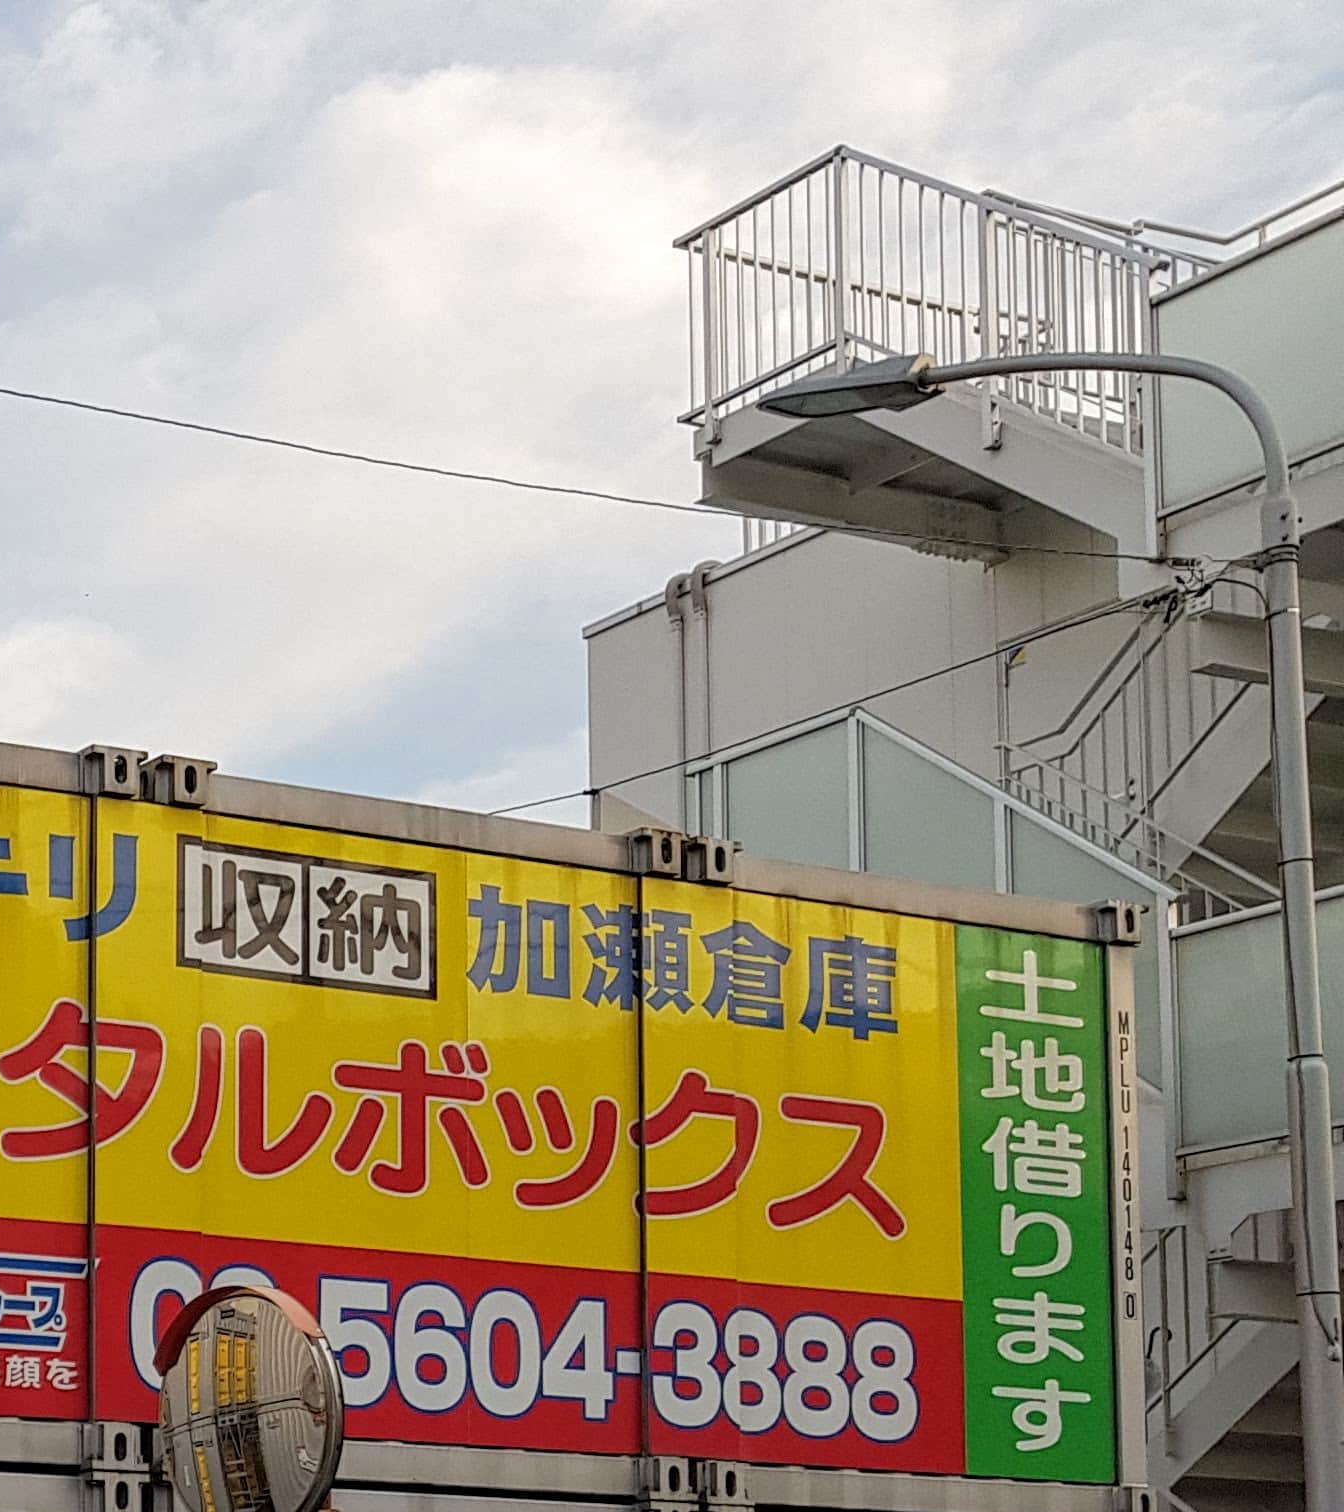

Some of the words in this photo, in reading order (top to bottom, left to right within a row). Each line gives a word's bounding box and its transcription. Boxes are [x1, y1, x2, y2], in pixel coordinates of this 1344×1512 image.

[195, 860, 424, 980] 収納
[467, 884, 899, 1040] 加瀬倉庫
[1118, 1011, 1131, 1113] MPLU
[979, 949, 1092, 1453] 土地借ります
[1123, 1126, 1134, 1280] 140148
